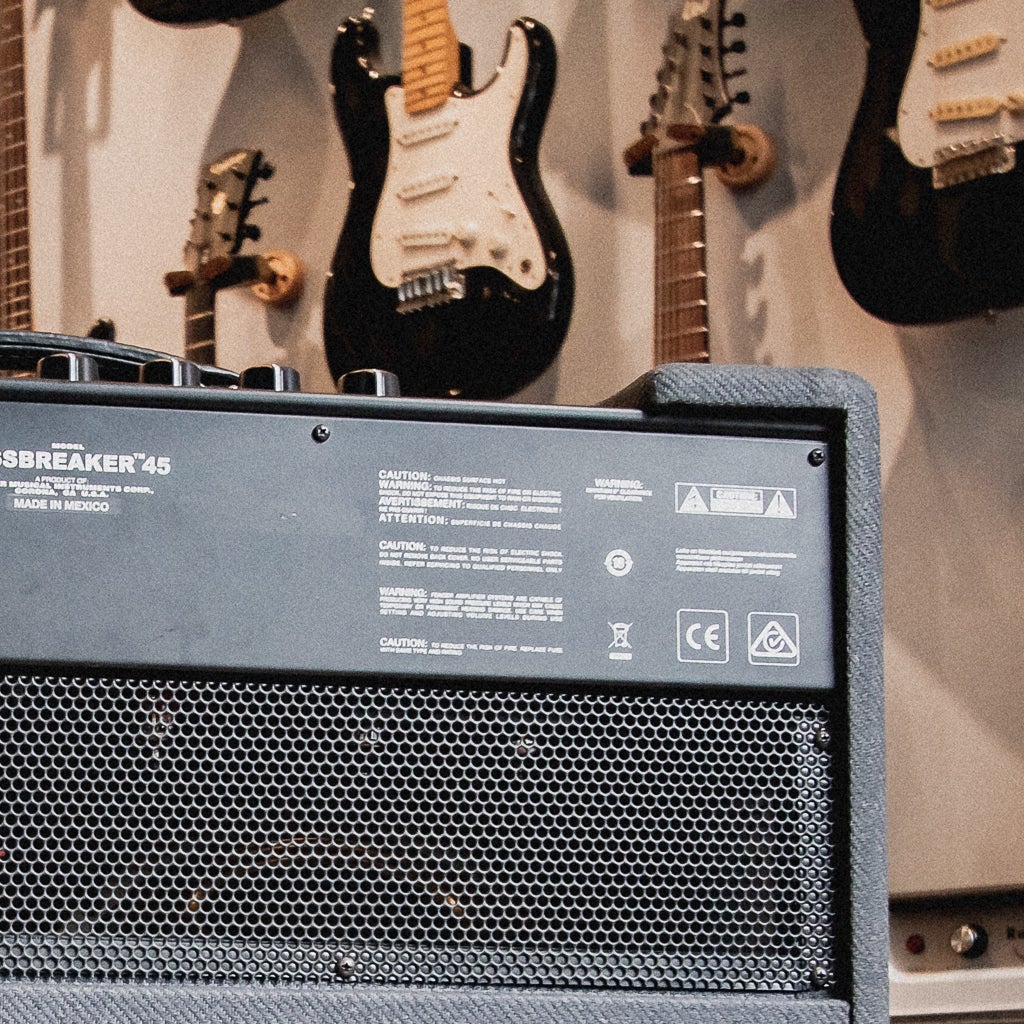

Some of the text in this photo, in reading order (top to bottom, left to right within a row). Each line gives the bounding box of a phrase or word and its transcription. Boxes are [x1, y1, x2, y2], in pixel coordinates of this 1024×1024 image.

[52, 442, 85, 450] MODEL
[378, 470, 432, 480] CAUTION:
[8, 480, 52, 490] MUSICAL
[54, 483, 122, 492] INSTRUMENTS
[378, 480, 432, 490] WARNING:
[594, 478, 644, 490] WARNING:
[14, 488, 58, 496] CORONA,
[80, 490, 109, 498] U.S.A.
[14, 498, 110, 512] MADE IN MEXICO
[378, 496, 466, 508] AVERTISSEMENT:
[378, 513, 448, 525] ATTENTION:
[378, 540, 426, 551] CAUTION:
[378, 587, 428, 597] WARNING:
[686, 623, 720, 650] CE
[379, 637, 428, 648] CAUTION:
